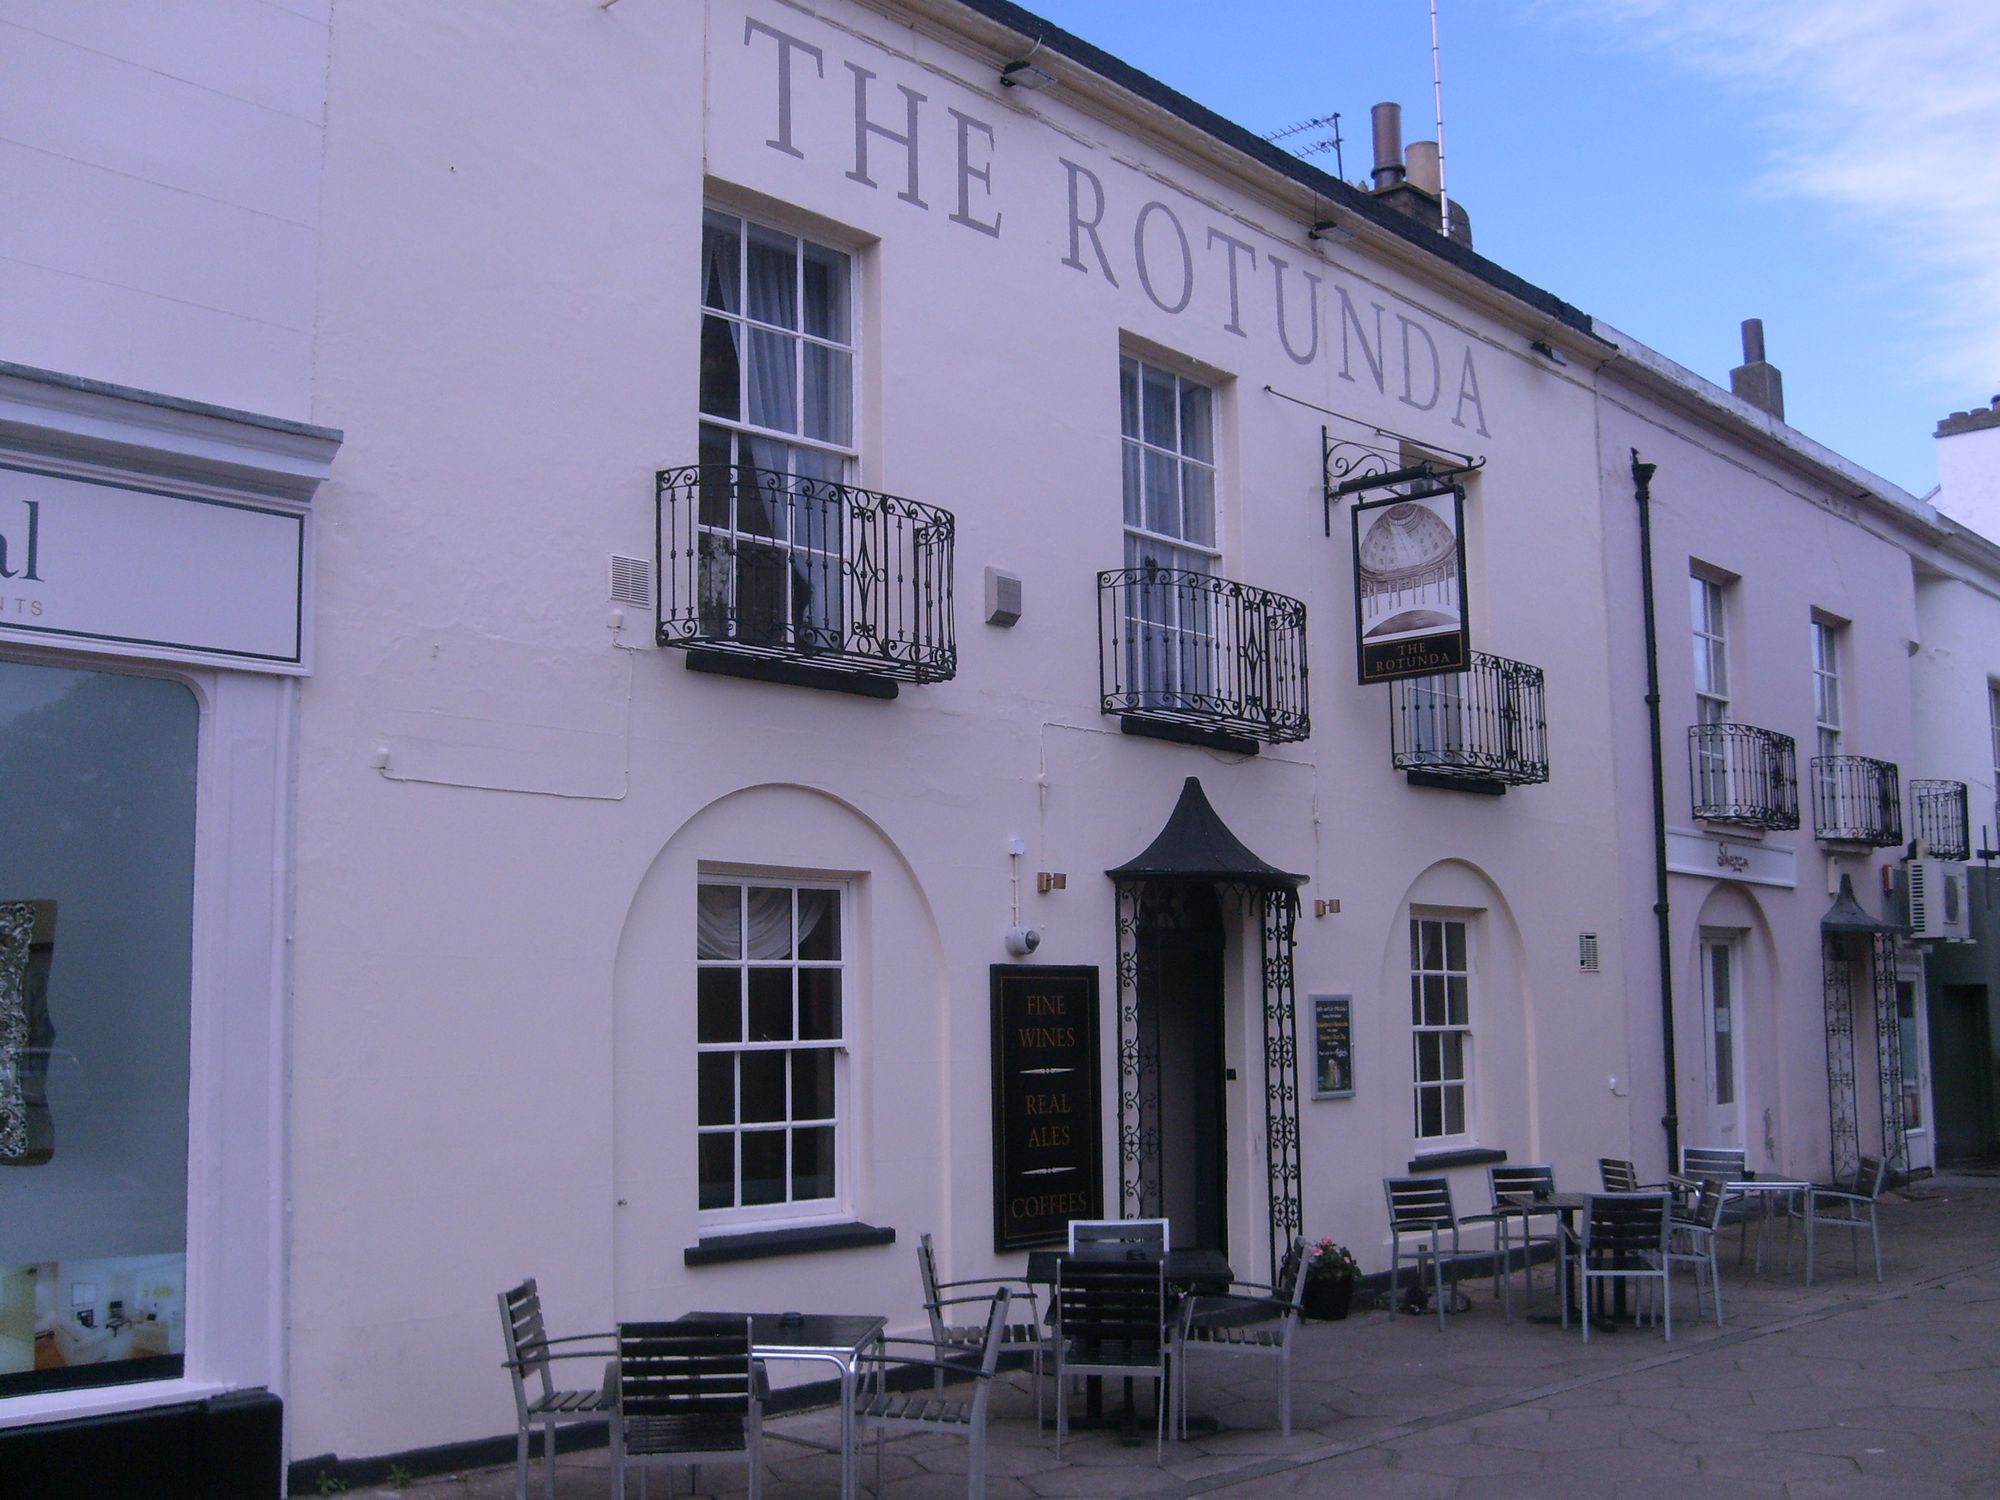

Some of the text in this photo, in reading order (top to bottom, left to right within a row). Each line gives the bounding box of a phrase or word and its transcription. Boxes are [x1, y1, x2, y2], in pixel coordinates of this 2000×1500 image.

[744, 16, 1491, 439] THE ROTUNDA
[1397, 642, 1427, 656] THE
[1376, 652, 1451, 672] ROTUNDA
[1026, 994, 1067, 1016] FINE
[1018, 1026, 1076, 1048] WINES
[1025, 1093, 1072, 1116] REAL
[1028, 1125, 1072, 1148] ALES
[1011, 1191, 1088, 1218] COFFEES
